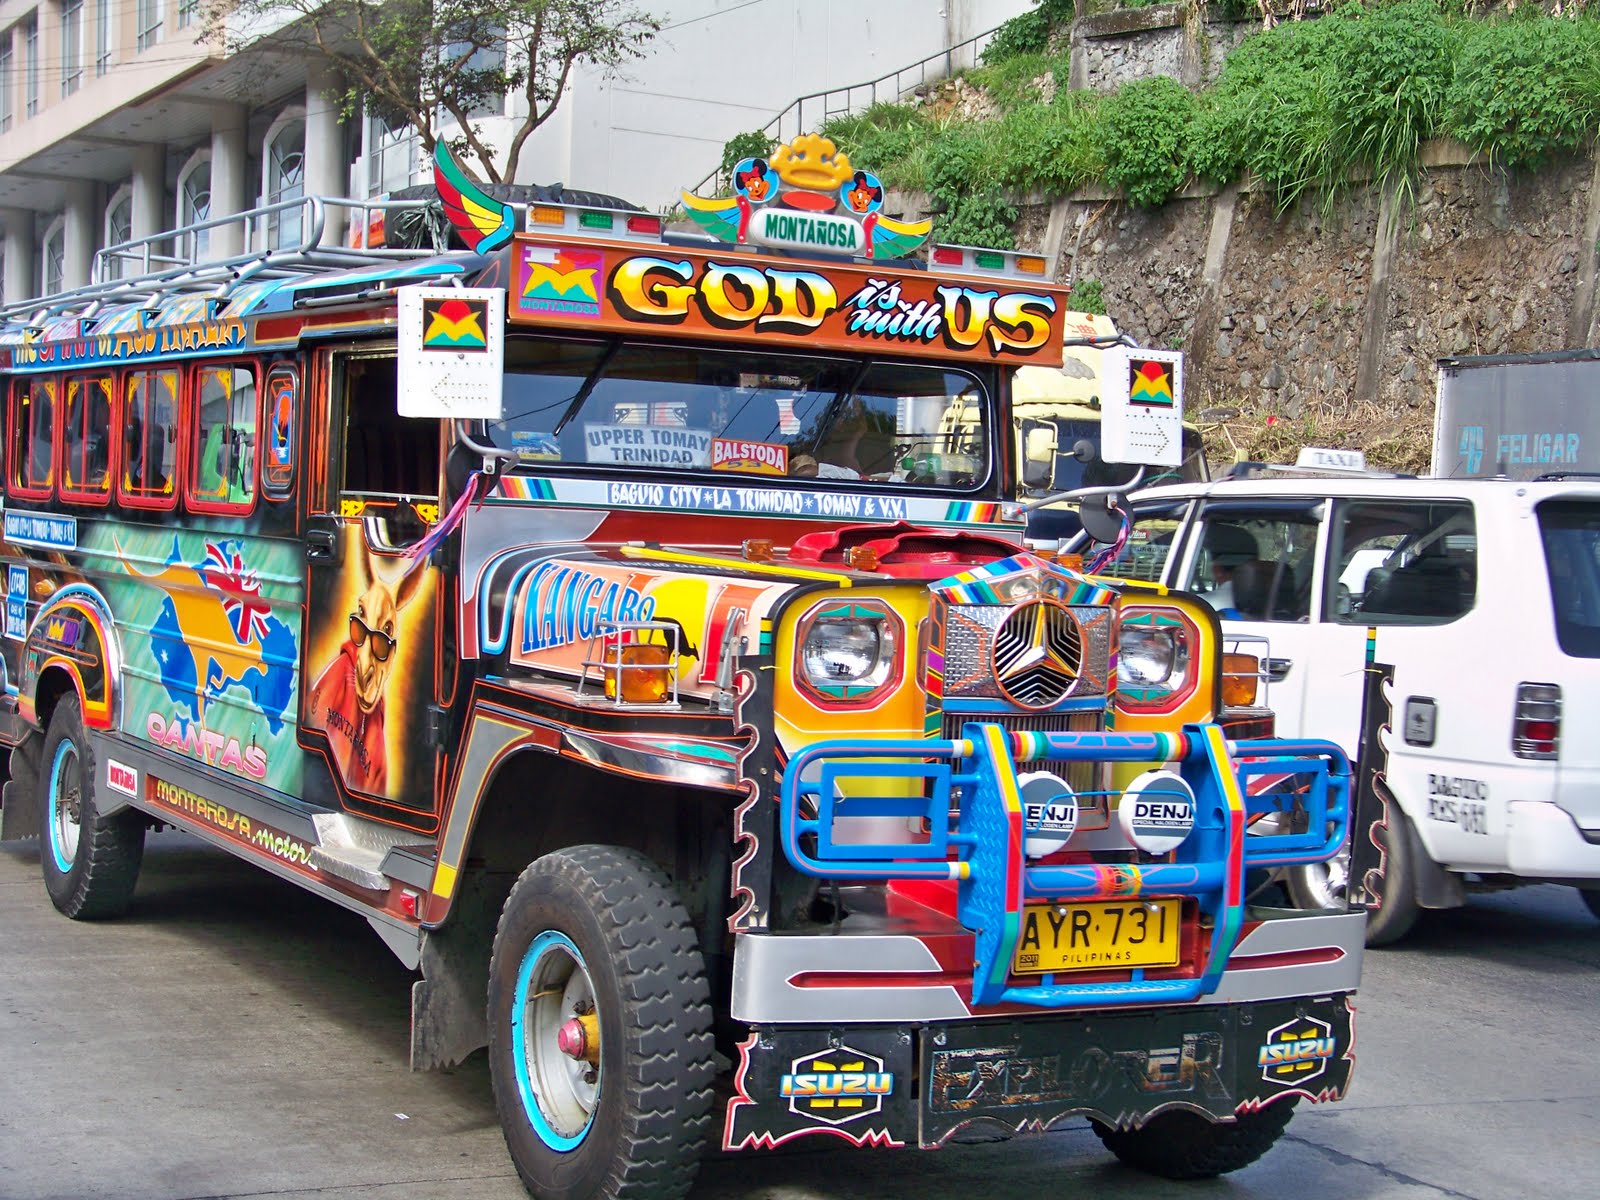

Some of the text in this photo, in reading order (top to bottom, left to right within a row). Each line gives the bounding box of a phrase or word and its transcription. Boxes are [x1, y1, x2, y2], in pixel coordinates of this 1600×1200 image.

[765, 213, 857, 249] MONTAÑOSA
[608, 255, 1057, 352] GOD is with US
[588, 429, 711, 452] UPPER TOMAY
[1496, 433, 1580, 464] FELIGAR
[611, 447, 693, 464] TRINIDAD
[713, 441, 786, 473] BALSTODA
[611, 483, 665, 506] BAGUIO
[669, 486, 701, 509] CITY
[713, 488, 732, 510] LA
[736, 489, 803, 514] TRINIDAD
[813, 493, 861, 517] TOMAY
[864, 497, 876, 516] &
[147, 712, 267, 778] QANTAS
[1026, 805, 1074, 822] ENJI
[1135, 803, 1193, 819] DENJI
[1061, 951, 1132, 964] PILIPINAS
[1259, 1038, 1335, 1066] ISUZU
[782, 1073, 892, 1096] ISUZU
